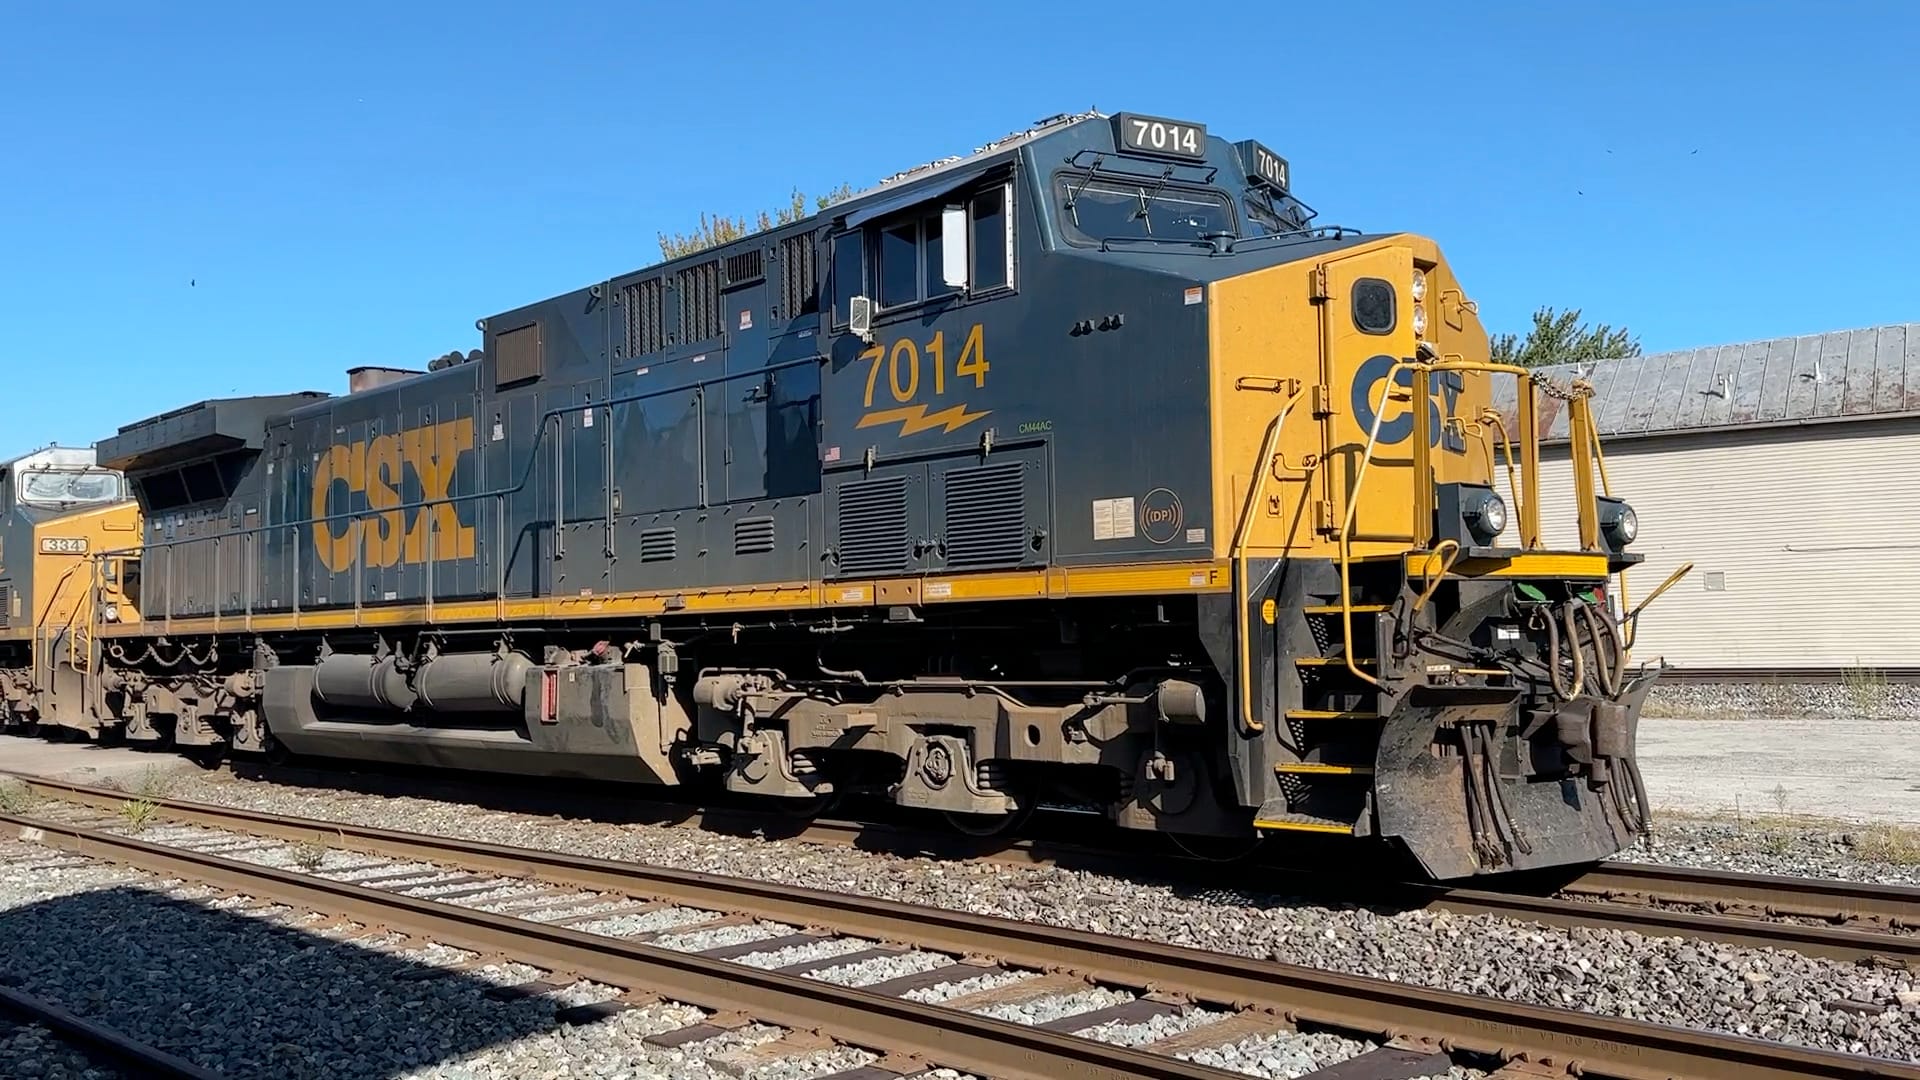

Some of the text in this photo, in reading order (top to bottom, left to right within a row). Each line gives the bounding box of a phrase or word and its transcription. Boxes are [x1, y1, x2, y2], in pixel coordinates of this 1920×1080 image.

[1133, 120, 1197, 154] 7014
[1257, 149, 1287, 188] 7014
[858, 323, 990, 408] 7014
[1018, 420, 1052, 434] CM44AC
[312, 416, 475, 573] CSX
[1209, 570, 1218, 584] F
